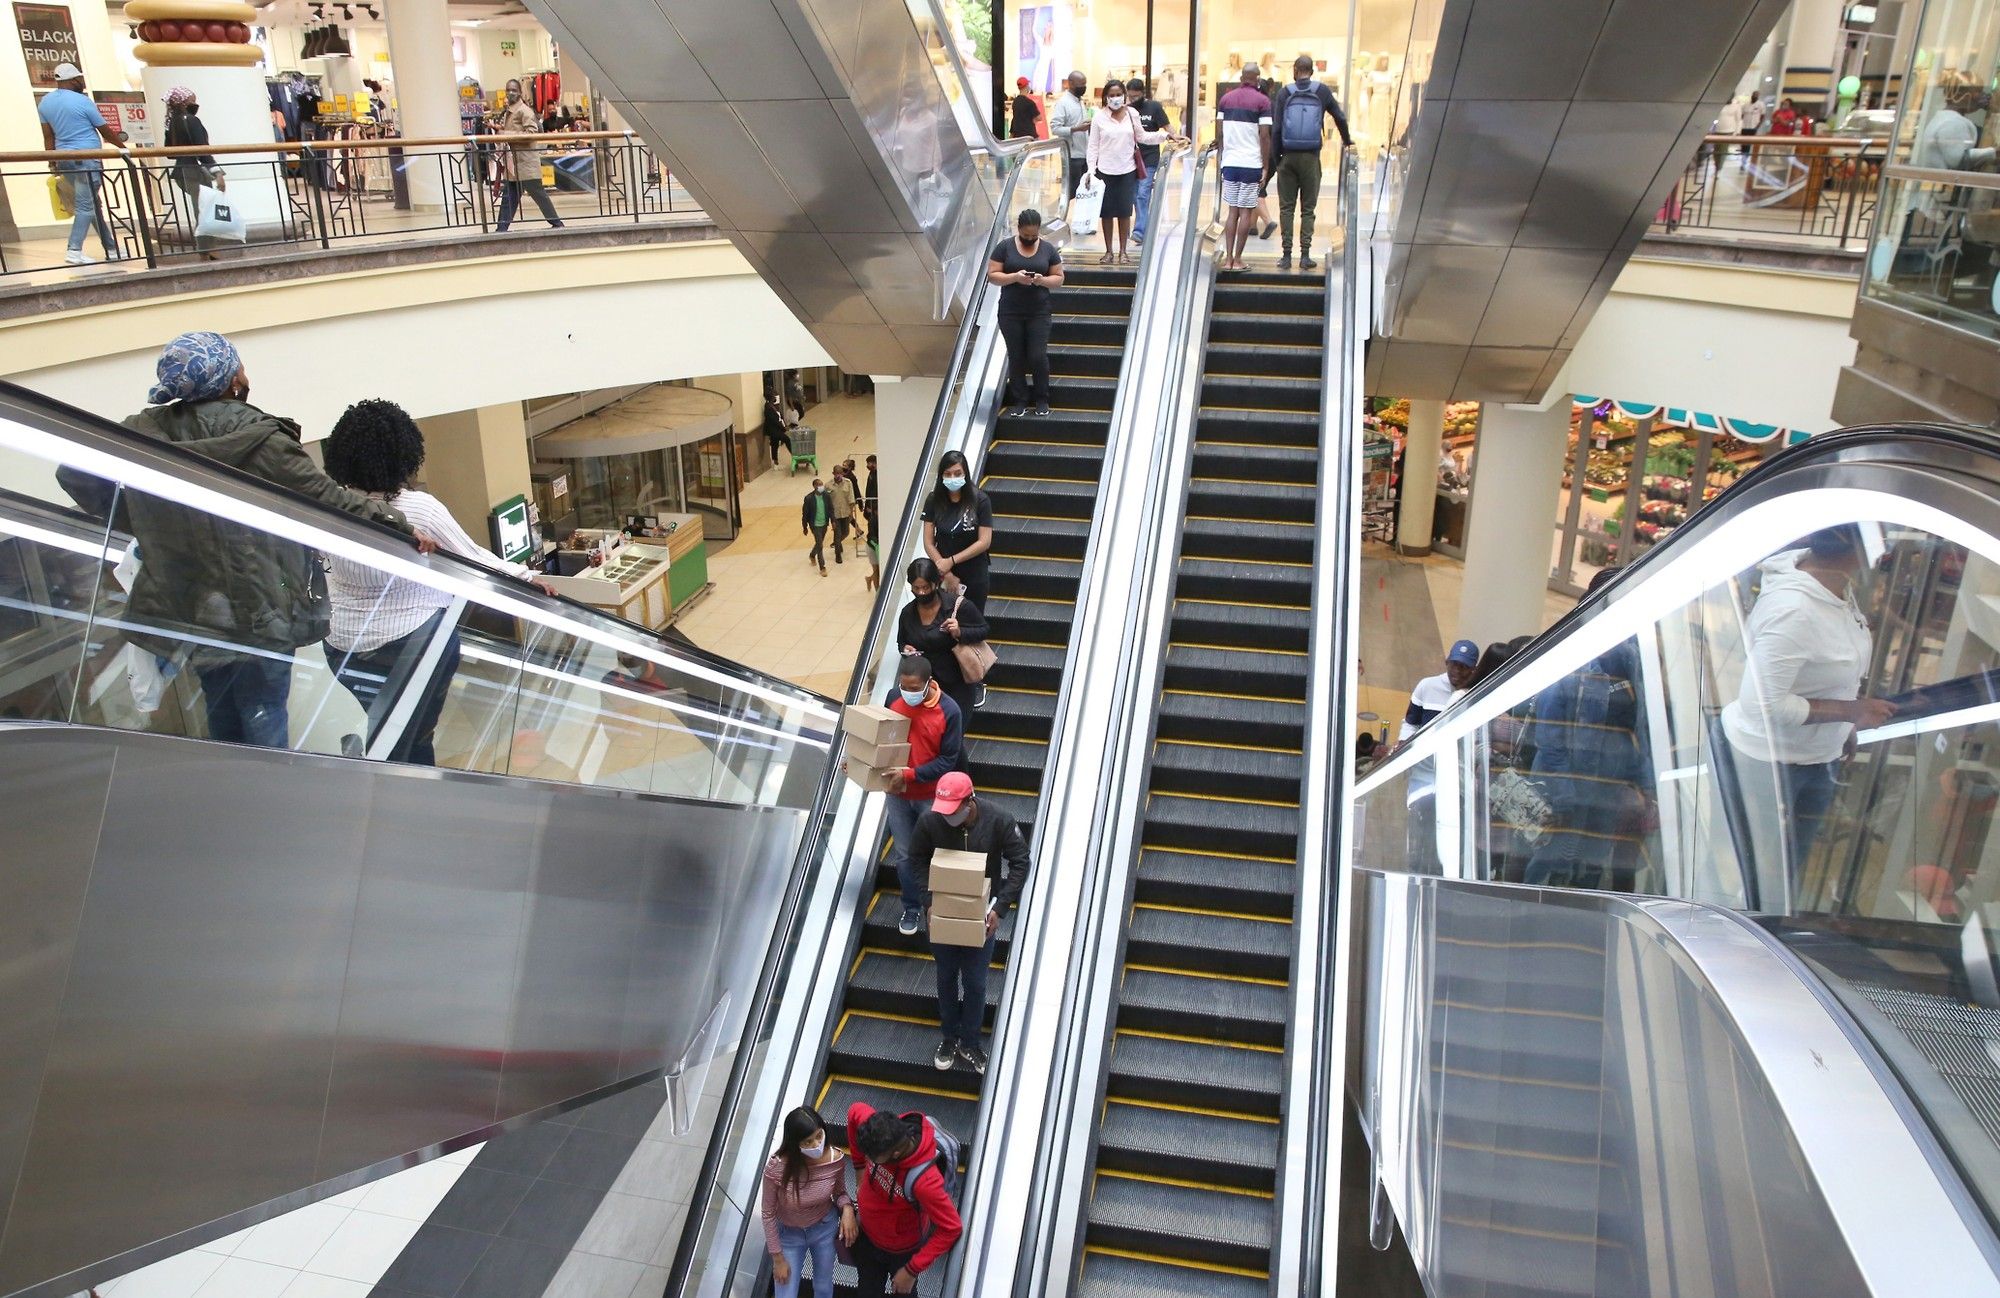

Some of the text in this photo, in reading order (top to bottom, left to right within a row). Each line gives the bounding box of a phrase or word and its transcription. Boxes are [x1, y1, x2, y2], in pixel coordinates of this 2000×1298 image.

[20, 29, 75, 44] BLACK
[24, 48, 77, 62] FRIDAY
[126, 108, 146, 120] 30
[217, 209, 229, 217] W
